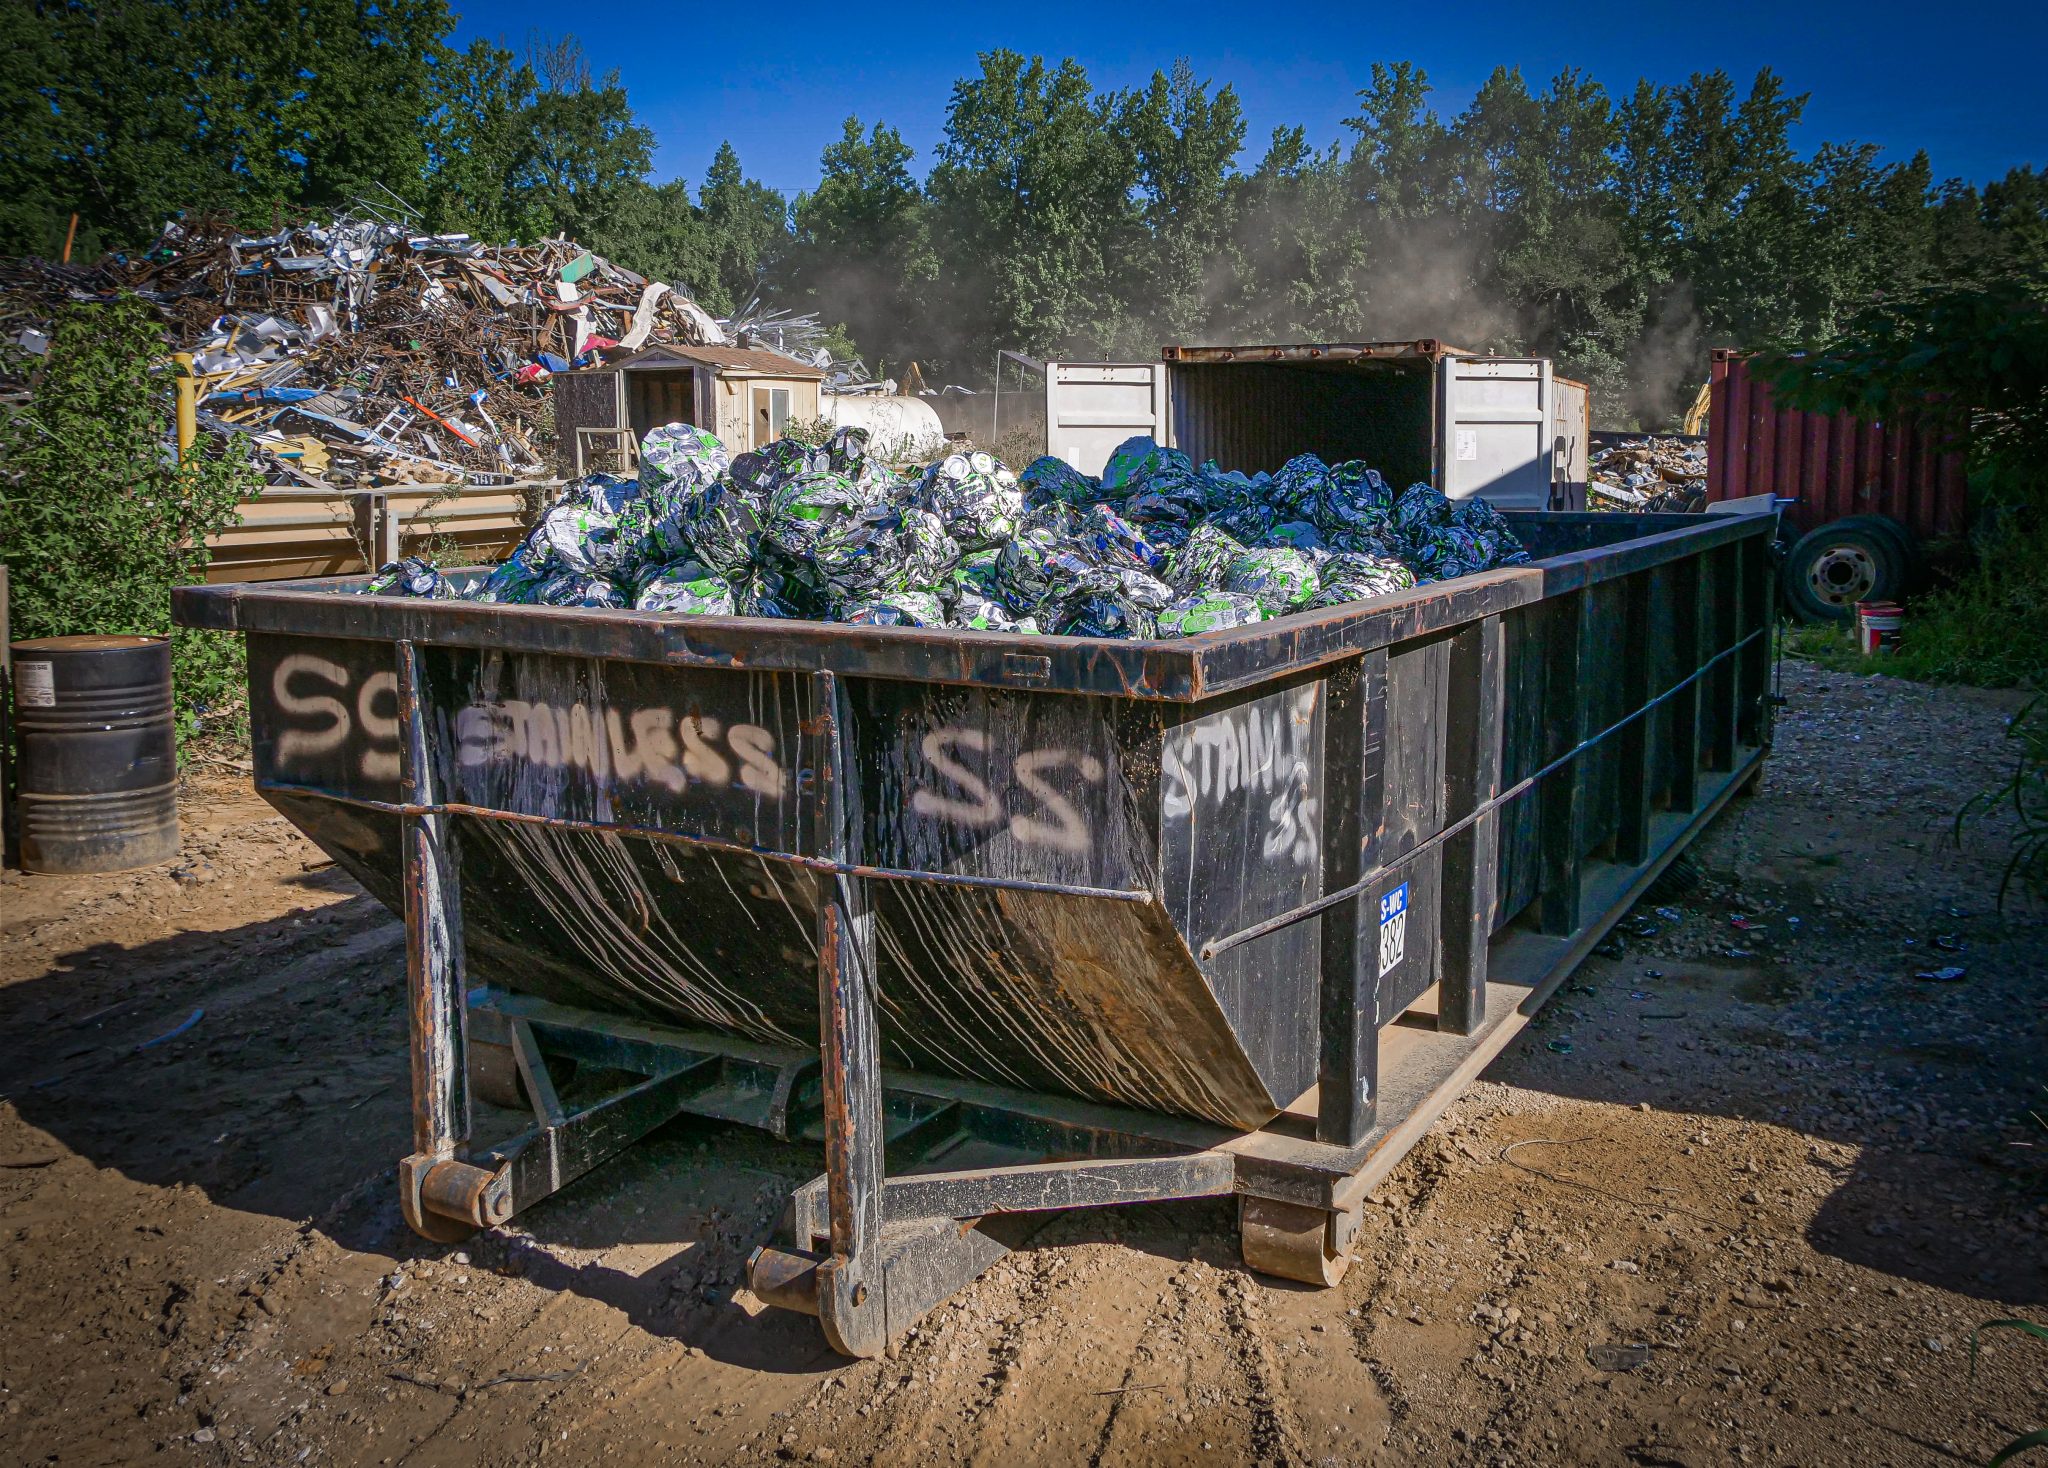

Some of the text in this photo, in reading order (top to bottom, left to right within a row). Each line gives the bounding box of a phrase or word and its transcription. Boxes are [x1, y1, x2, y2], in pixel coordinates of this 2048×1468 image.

[914, 729, 1104, 850] SS
[1380, 889, 1403, 921] S-WC
[1382, 913, 1404, 970] 382
